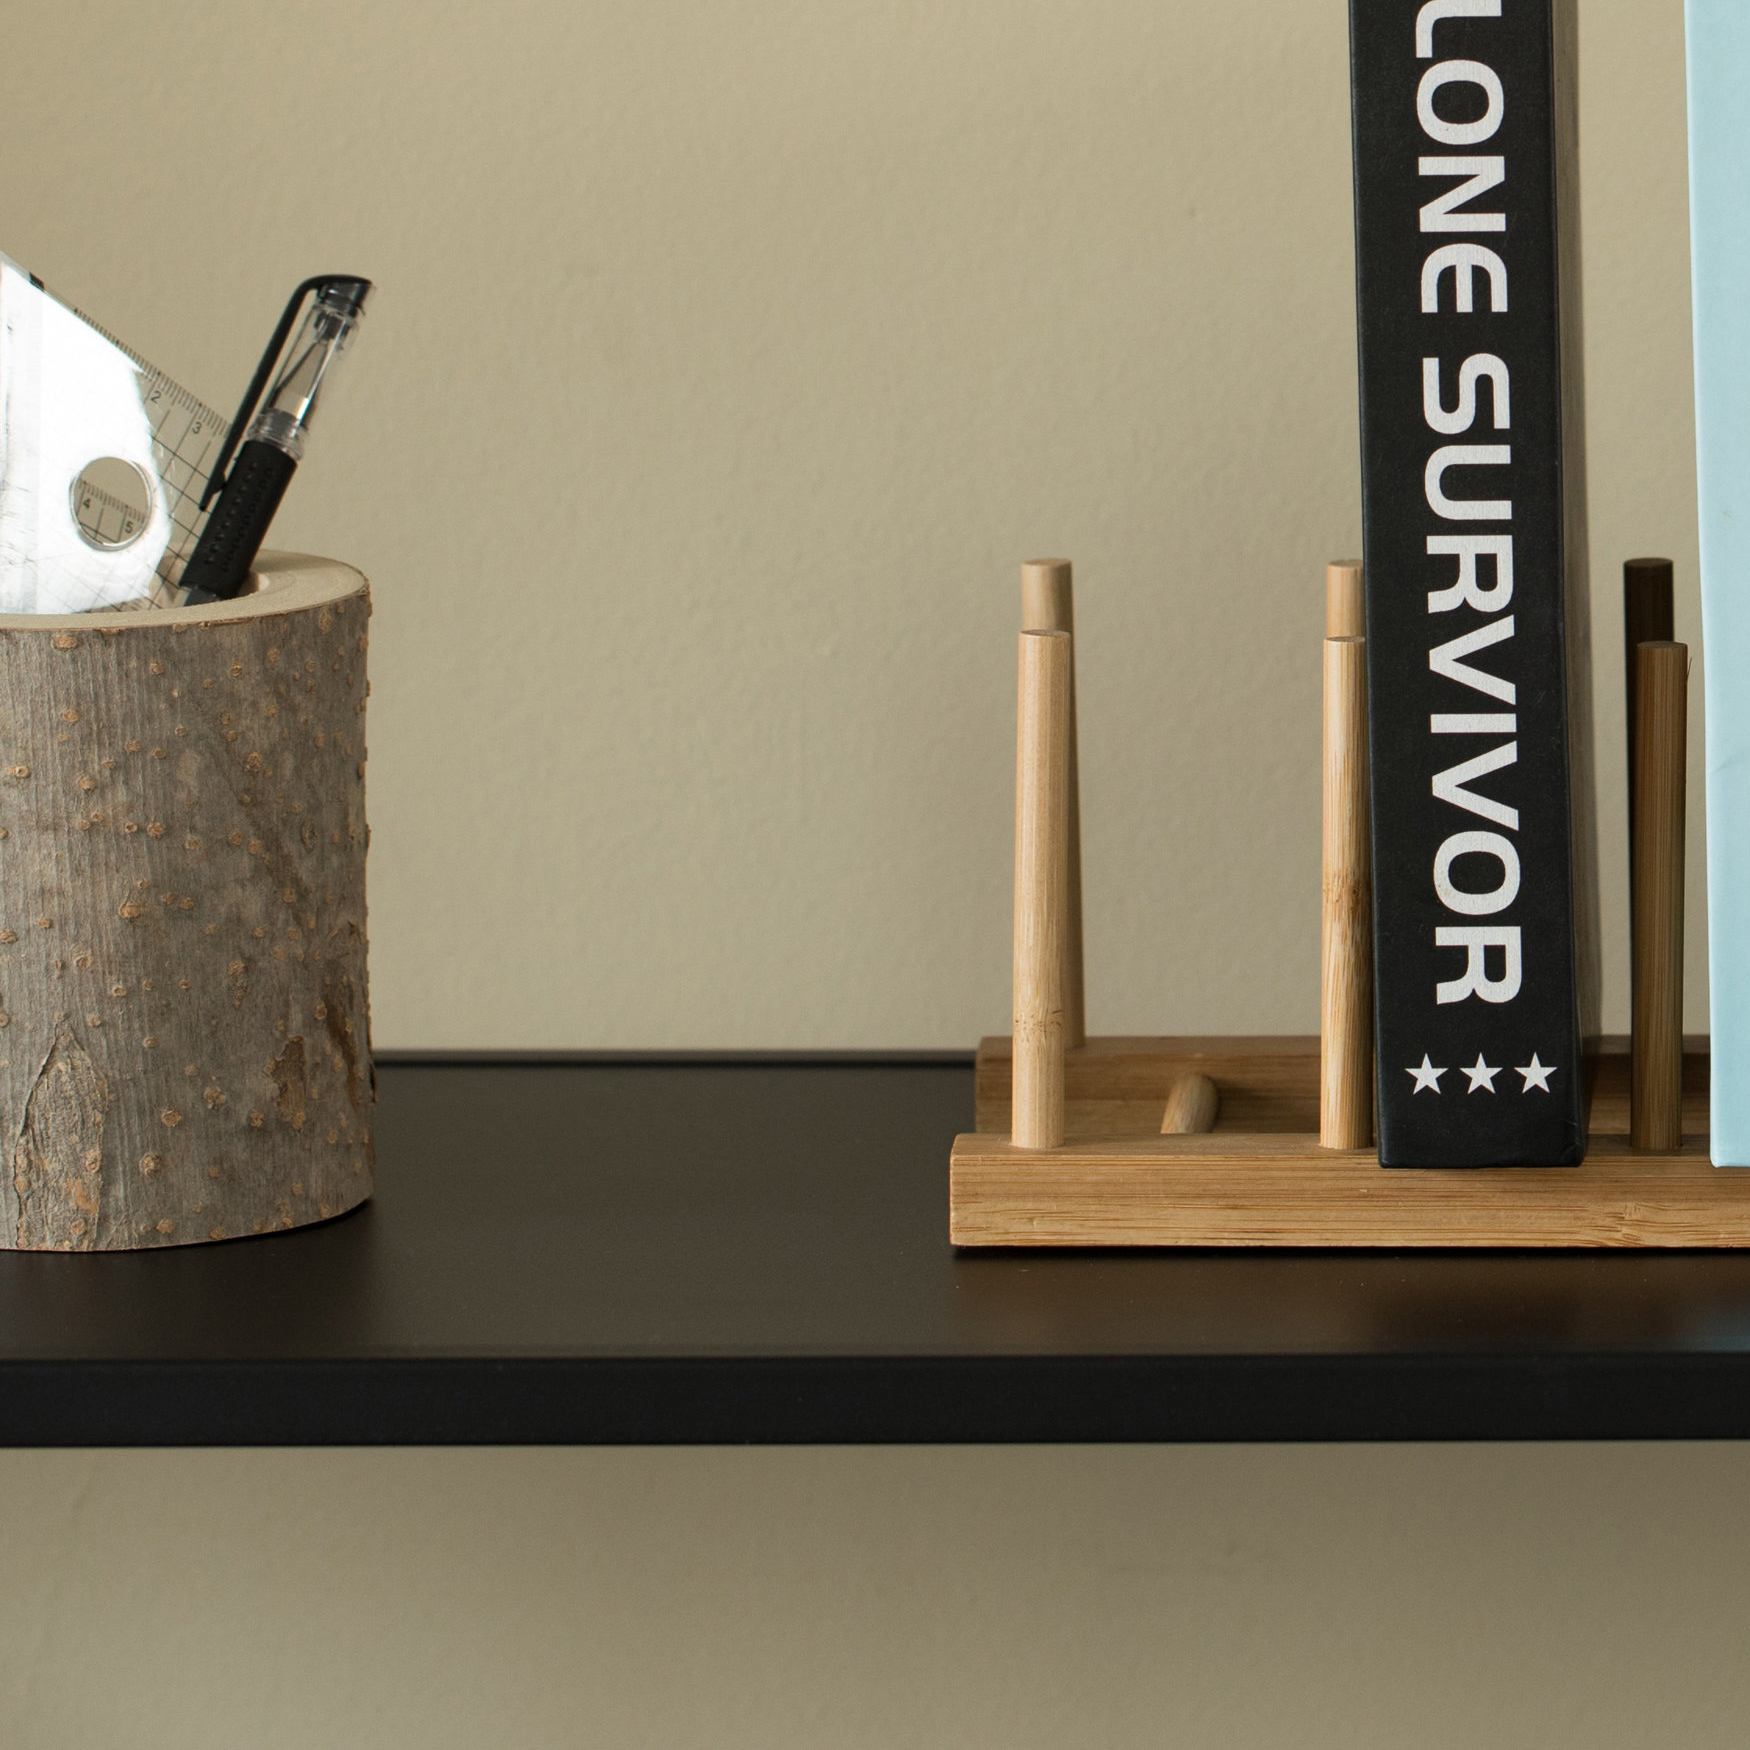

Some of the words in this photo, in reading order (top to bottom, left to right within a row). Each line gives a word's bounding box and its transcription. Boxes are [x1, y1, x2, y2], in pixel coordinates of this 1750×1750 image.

[151, 390, 161, 403] 2
[192, 421, 202, 434] 3
[83, 497, 91, 509] 4
[125, 521, 134, 534] 5
[1422, 352, 1522, 1005] SURVIVOR
